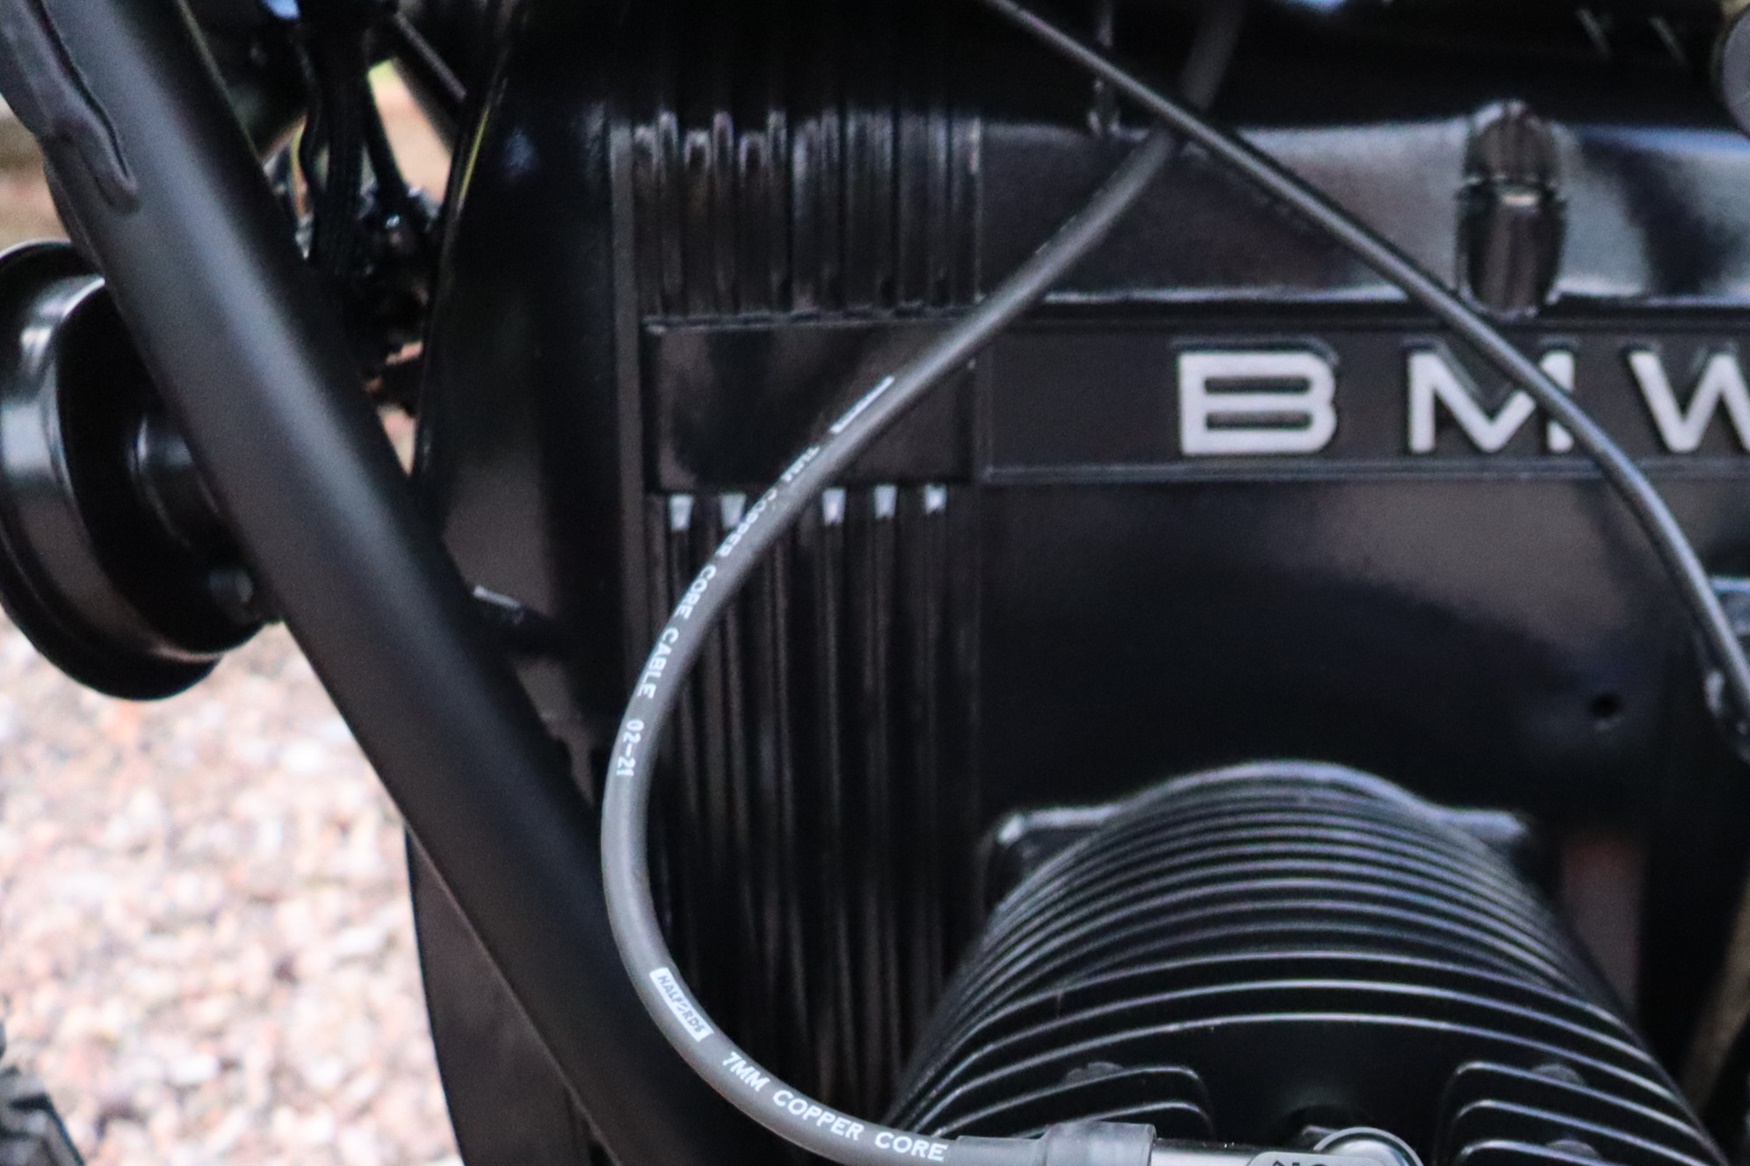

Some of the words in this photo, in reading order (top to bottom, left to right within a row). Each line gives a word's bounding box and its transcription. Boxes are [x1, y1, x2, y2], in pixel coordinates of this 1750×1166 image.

[674, 565, 717, 620] CORE
[637, 627, 680, 699] CABLE
[616, 719, 645, 777] 02-21
[722, 1051, 771, 1092] 7MM
[773, 1090, 865, 1141] COPPER
[875, 1131, 949, 1162] CORE
